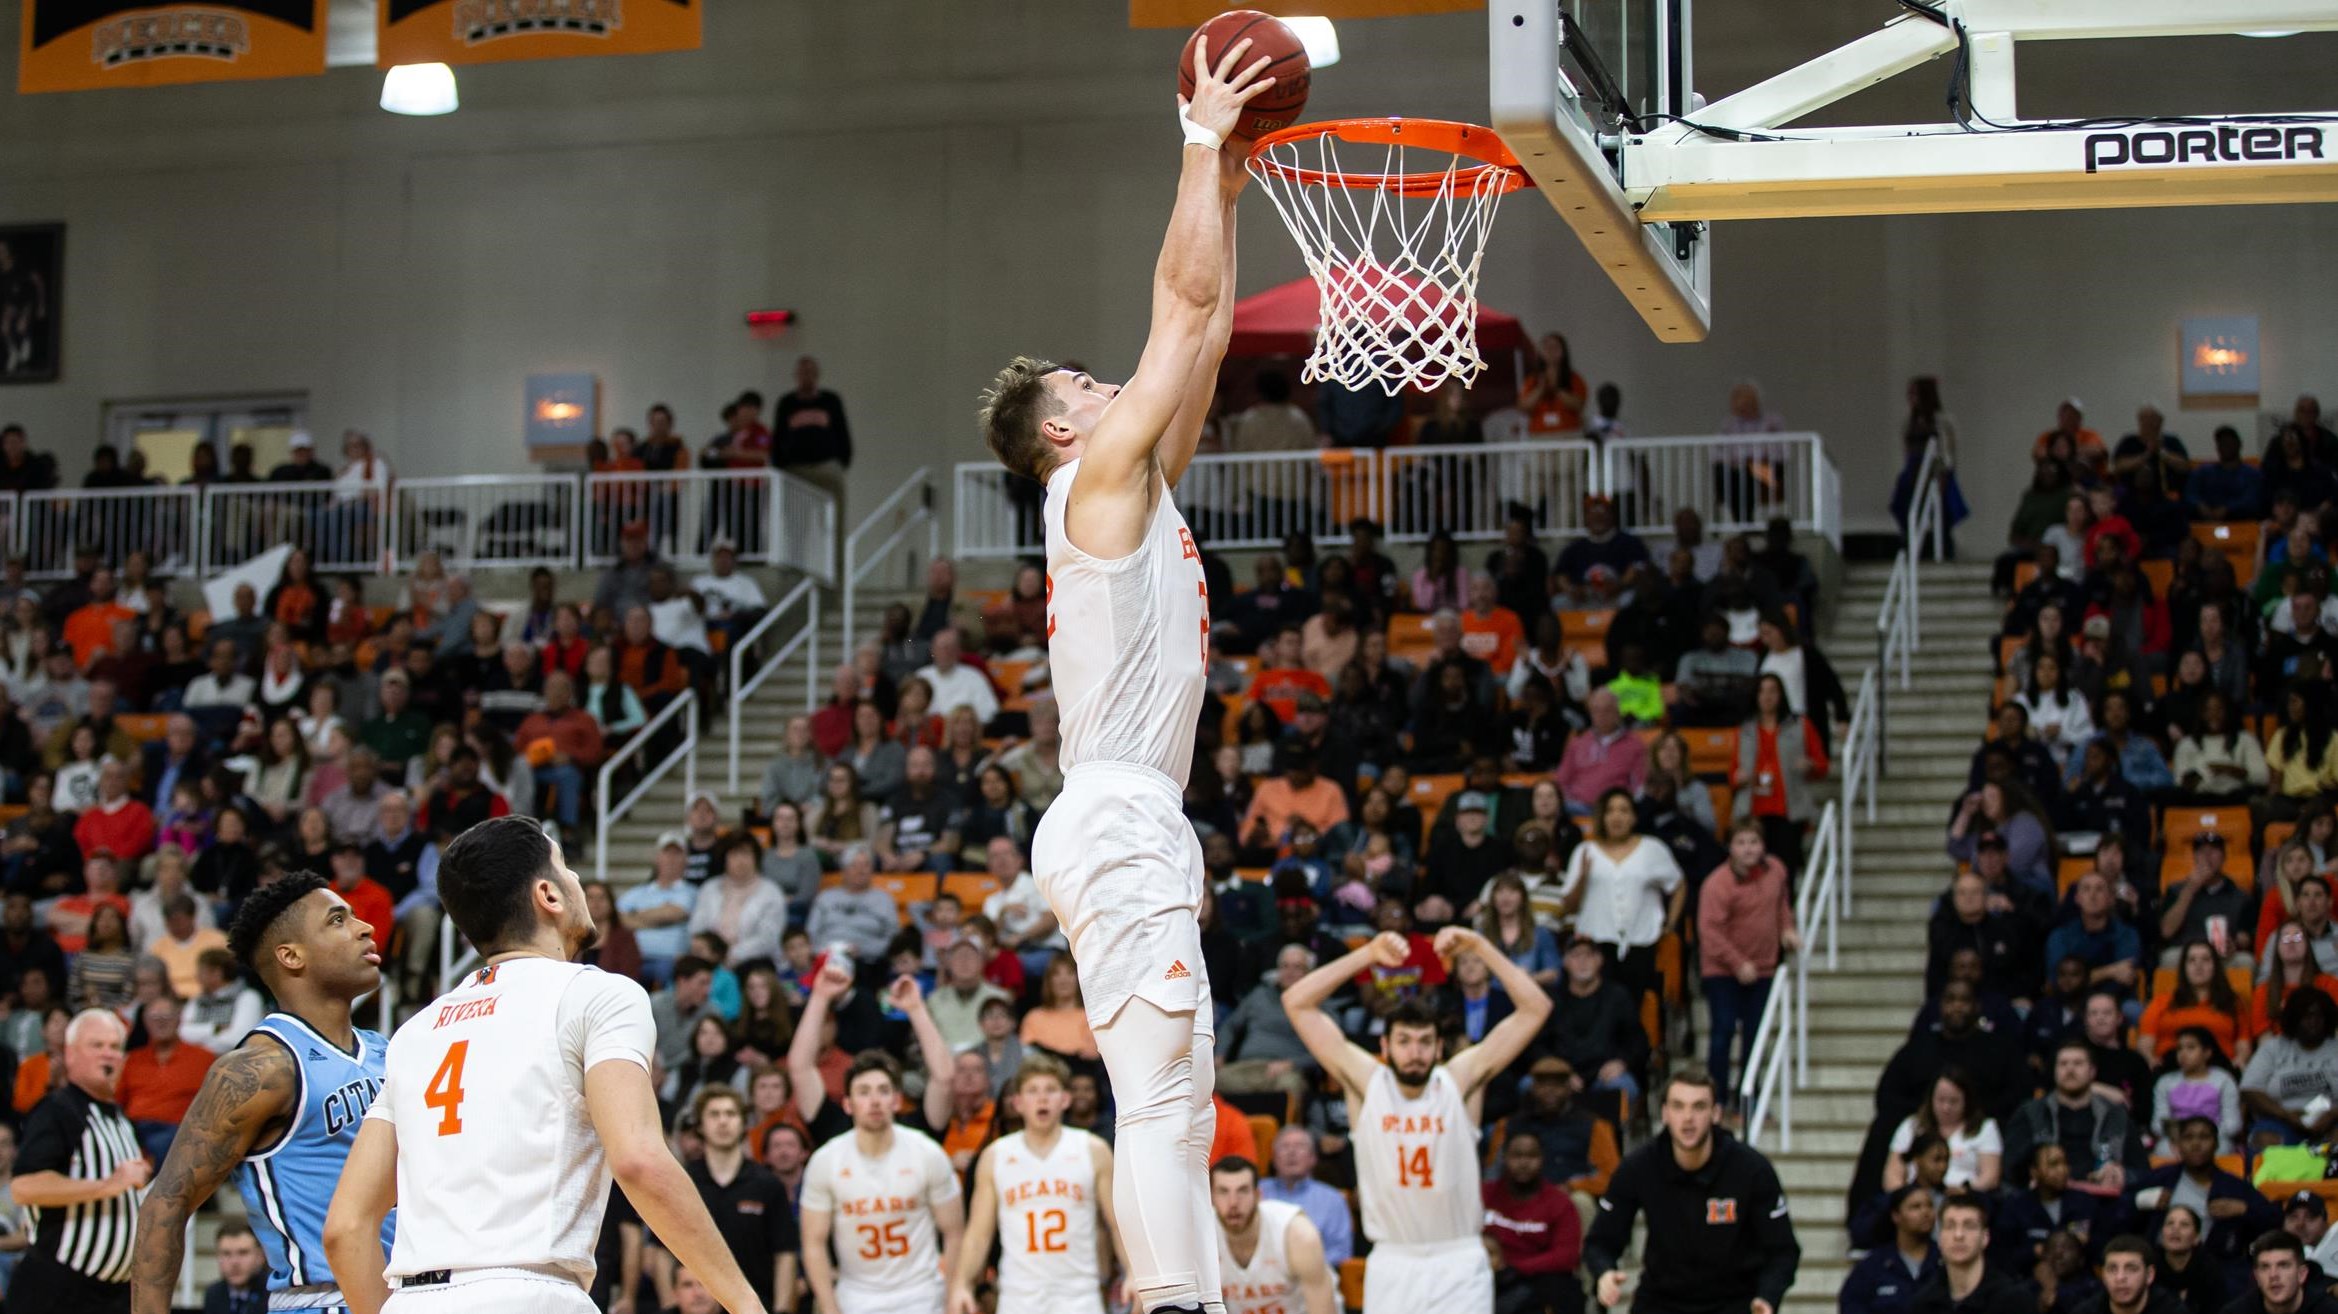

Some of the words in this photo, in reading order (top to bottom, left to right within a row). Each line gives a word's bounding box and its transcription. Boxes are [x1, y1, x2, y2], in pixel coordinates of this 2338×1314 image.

[433, 994, 502, 1030] RIVERA
[323, 1076, 386, 1136] CITA
[424, 1039, 470, 1137] 4
[1398, 1144, 1434, 1189] 14
[842, 1195, 919, 1216] BEARS
[1004, 1178, 1084, 1207] BEARS
[856, 1217, 910, 1260] 35
[1026, 1208, 1068, 1253] 12
